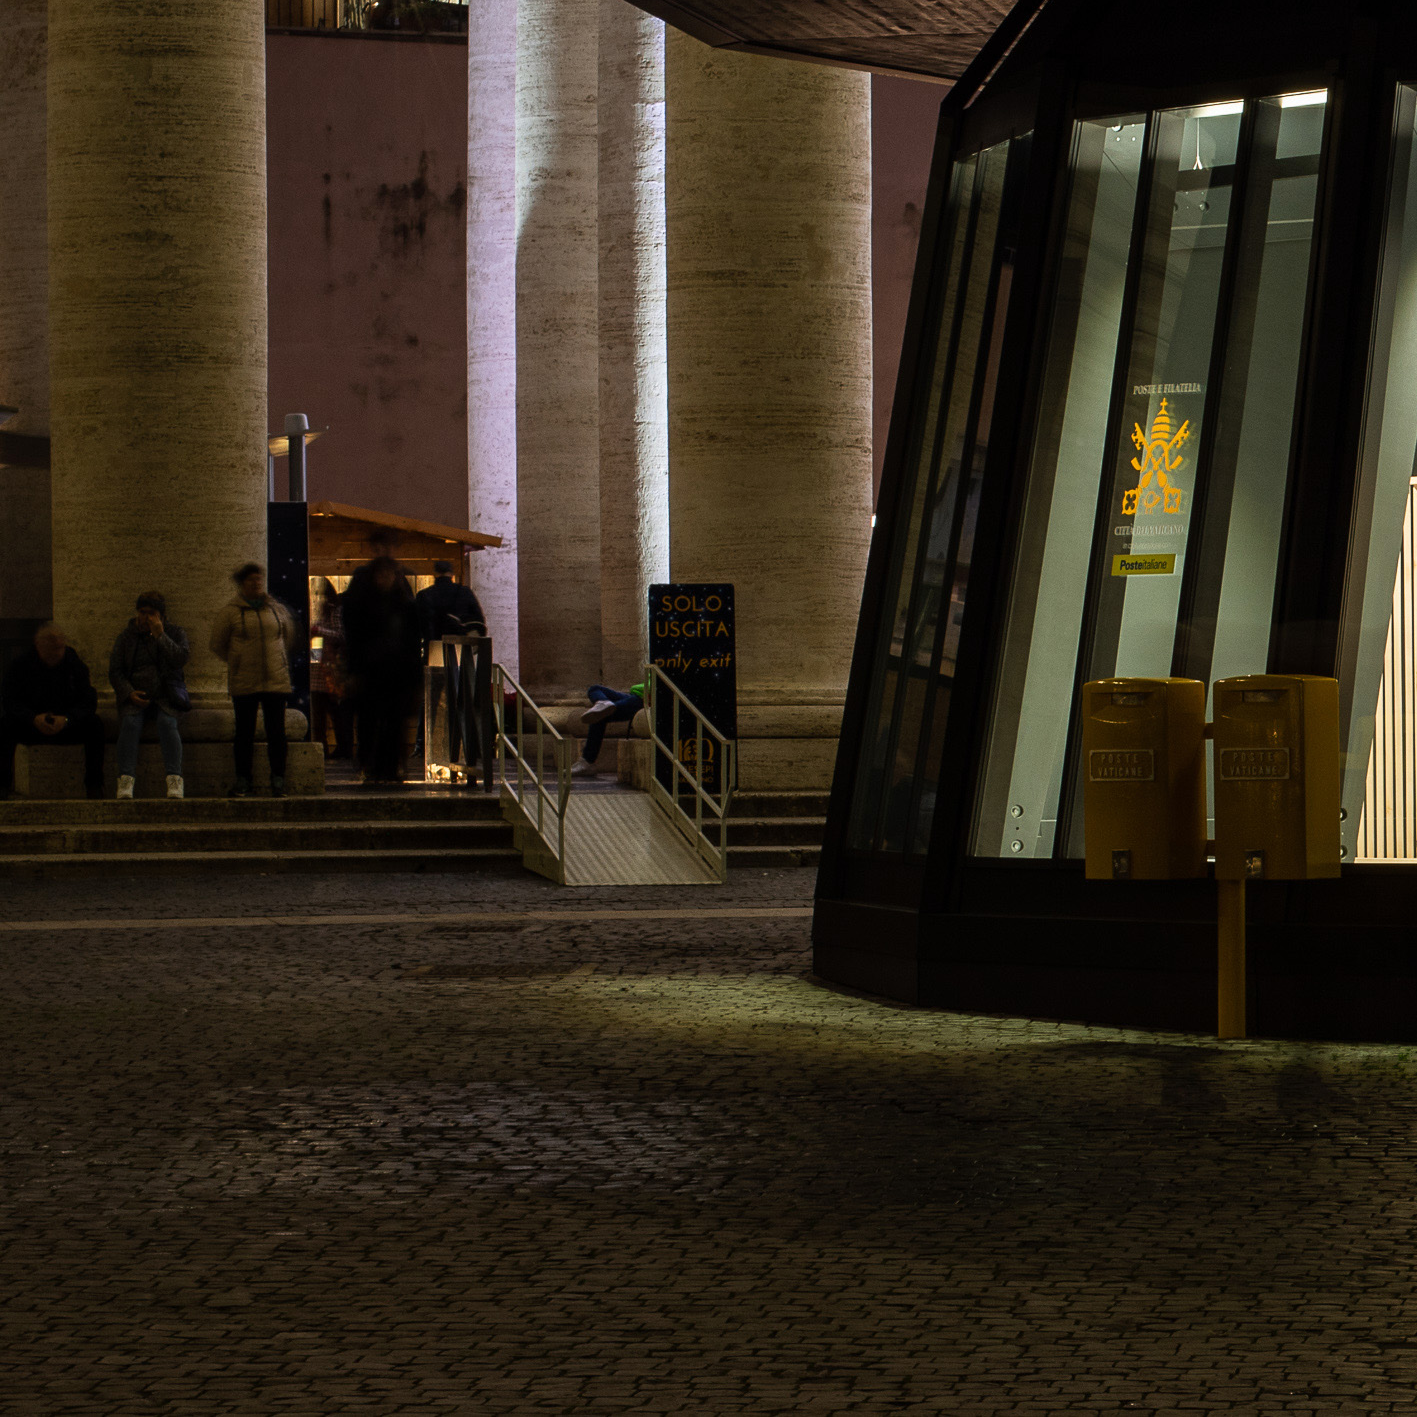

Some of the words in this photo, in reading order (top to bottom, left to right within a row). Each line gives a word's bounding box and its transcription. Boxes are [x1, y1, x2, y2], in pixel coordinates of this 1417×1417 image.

[1133, 384, 1156, 395] POSTE
[1163, 382, 1202, 393] FILATELIA
[1120, 558, 1168, 571] Posteitaliane
[661, 595, 722, 612] SOLO
[655, 620, 729, 638] USCITA
[654, 650, 693, 673] only
[699, 652, 732, 669] exit
[1101, 753, 1139, 764] POSTE
[1232, 751, 1275, 762] POSTE
[1097, 766, 1144, 778] VATICANE
[1229, 765, 1279, 776] VATICANE
